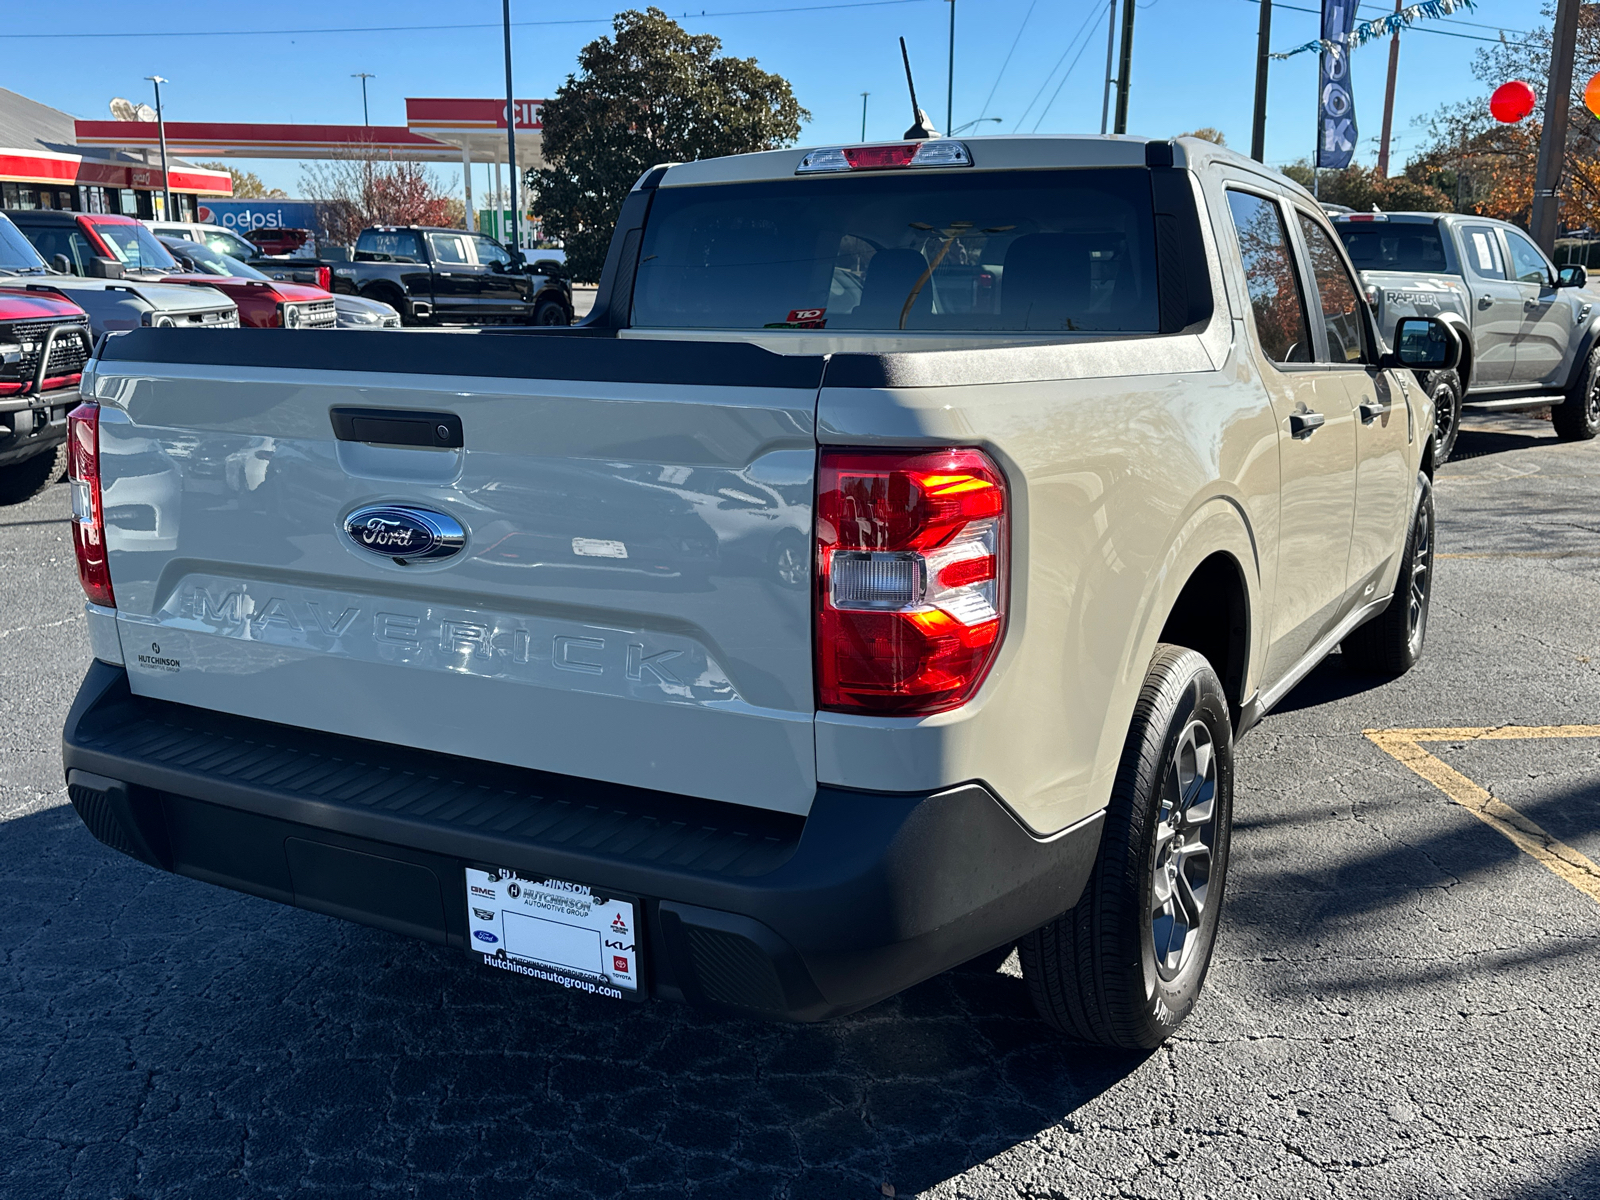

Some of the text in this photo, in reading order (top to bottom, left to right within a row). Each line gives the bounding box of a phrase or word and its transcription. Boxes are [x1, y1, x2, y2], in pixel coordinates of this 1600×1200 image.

[1322, 5, 1354, 151] LOOK
[222, 209, 282, 230] pepsi
[1386, 291, 1441, 311] RAPTOR
[362, 517, 414, 546] Ford
[191, 586, 686, 687] MAVERICK
[138, 654, 181, 668] HUTCHINSON
[471, 885, 496, 897] GMC
[523, 888, 591, 912] HUTCHINSON
[524, 899, 589, 918] AUTOMOTIVE GROUP
[484, 954, 622, 999] Hutchinsonautogroup.com
[612, 972, 632, 982] TOYOTA
